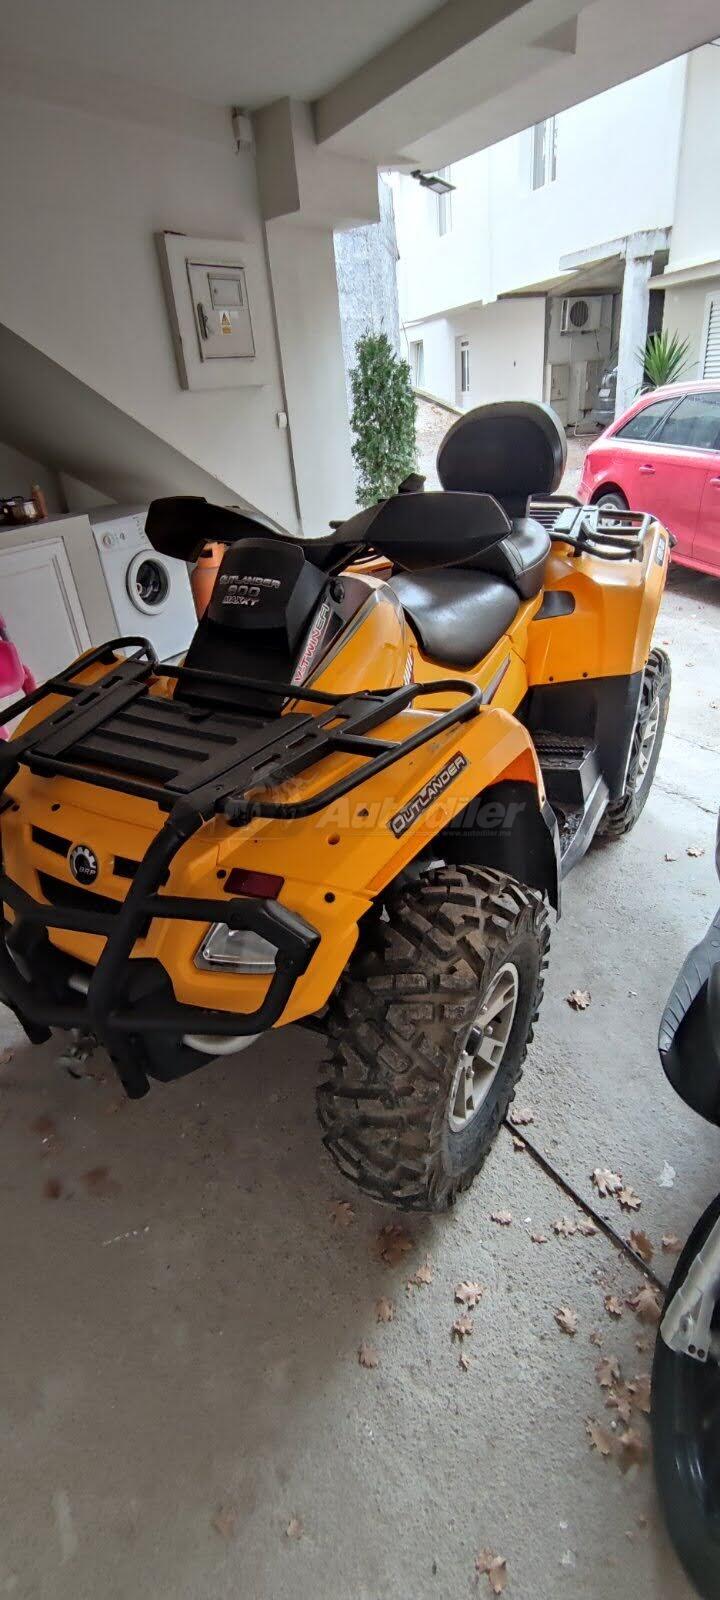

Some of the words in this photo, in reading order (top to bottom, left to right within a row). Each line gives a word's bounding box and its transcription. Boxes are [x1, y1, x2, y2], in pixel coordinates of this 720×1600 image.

[220, 574, 281, 589] OUTLANDER
[391, 755, 466, 834] OUTLANDER
[80, 866, 97, 875] BRP
